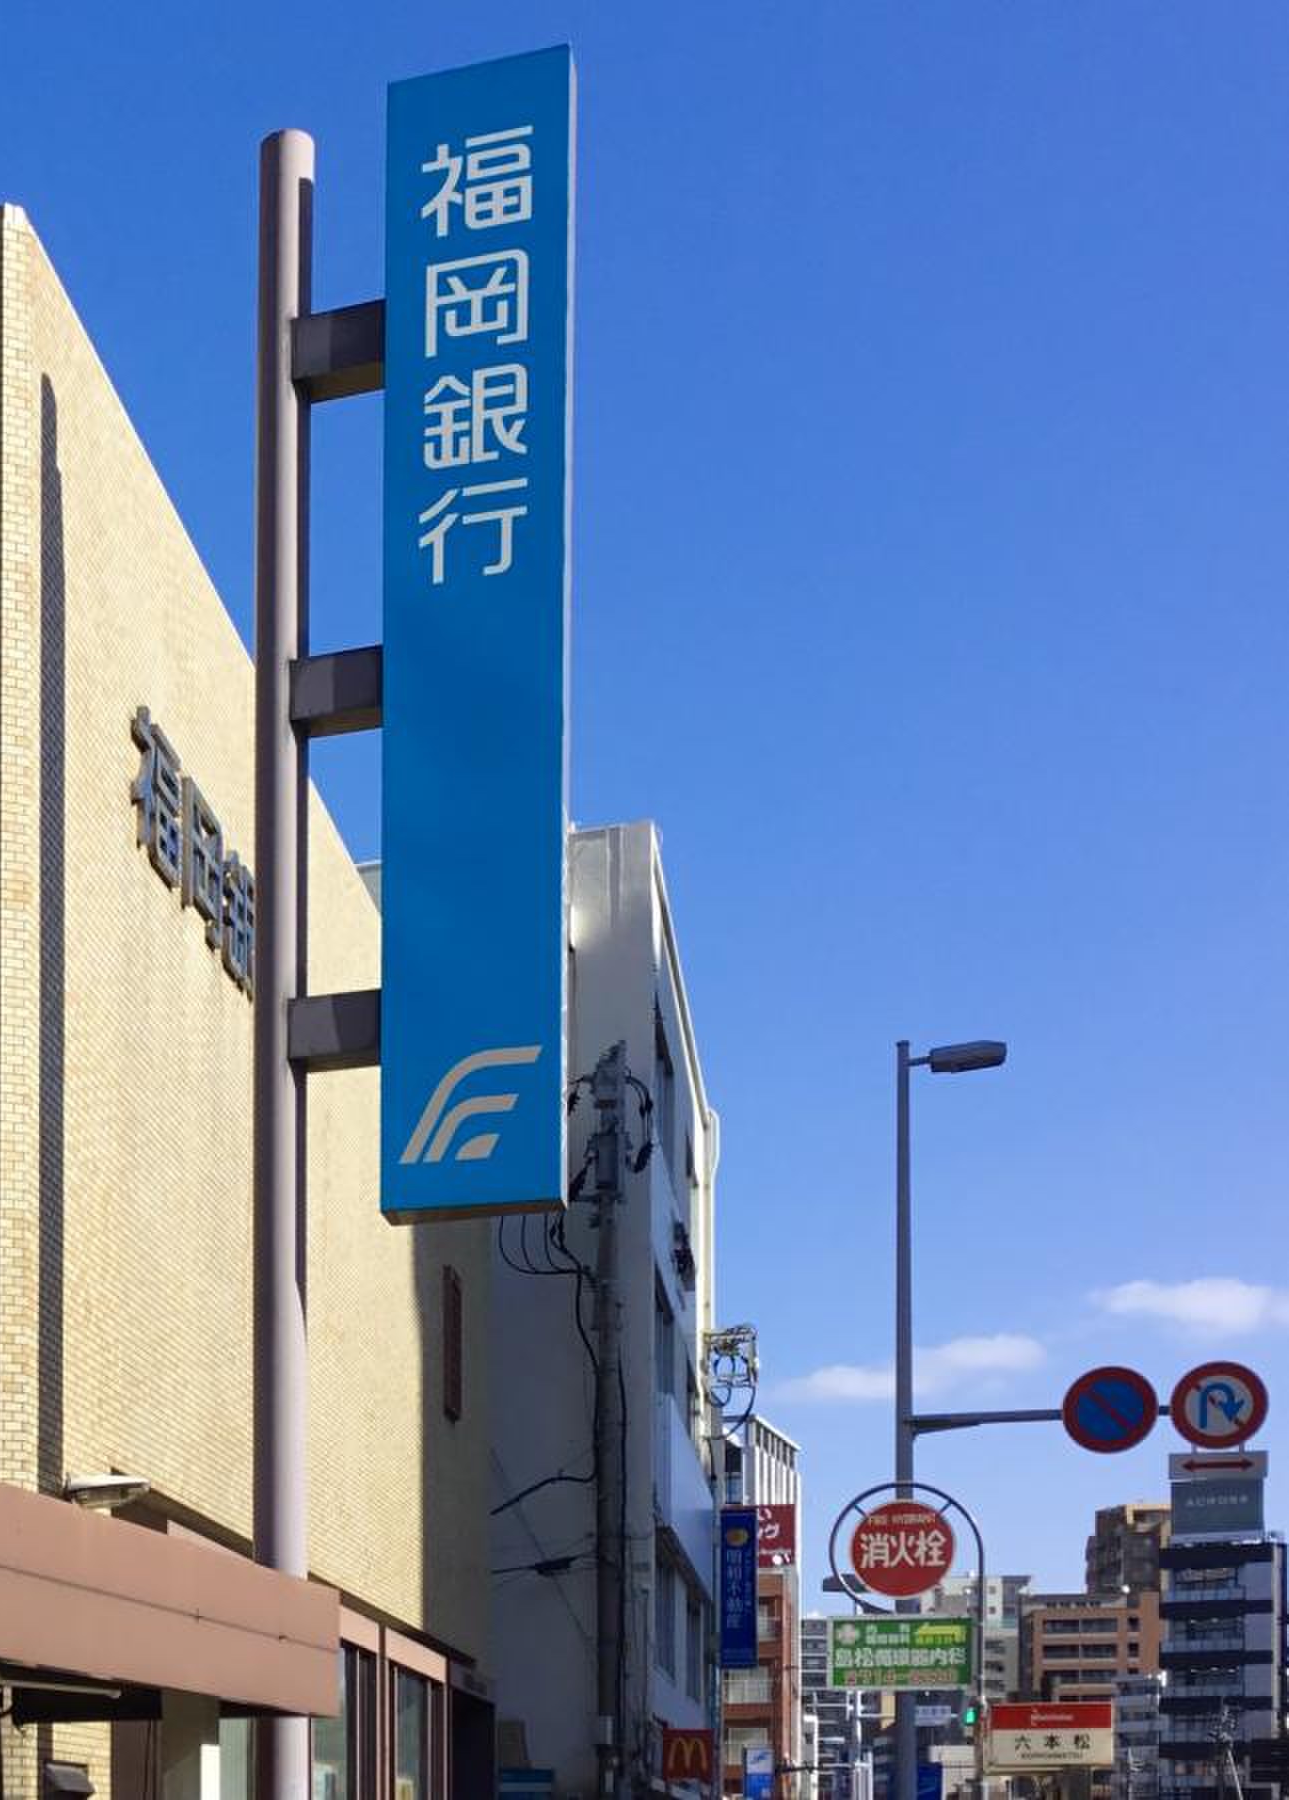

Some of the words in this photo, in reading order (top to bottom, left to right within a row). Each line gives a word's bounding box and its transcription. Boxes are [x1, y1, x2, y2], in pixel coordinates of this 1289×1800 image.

[418, 124, 534, 586] 福岡銀行
[860, 1529, 947, 1568] 消火栓
[1014, 1733, 1091, 1750] 六本松
